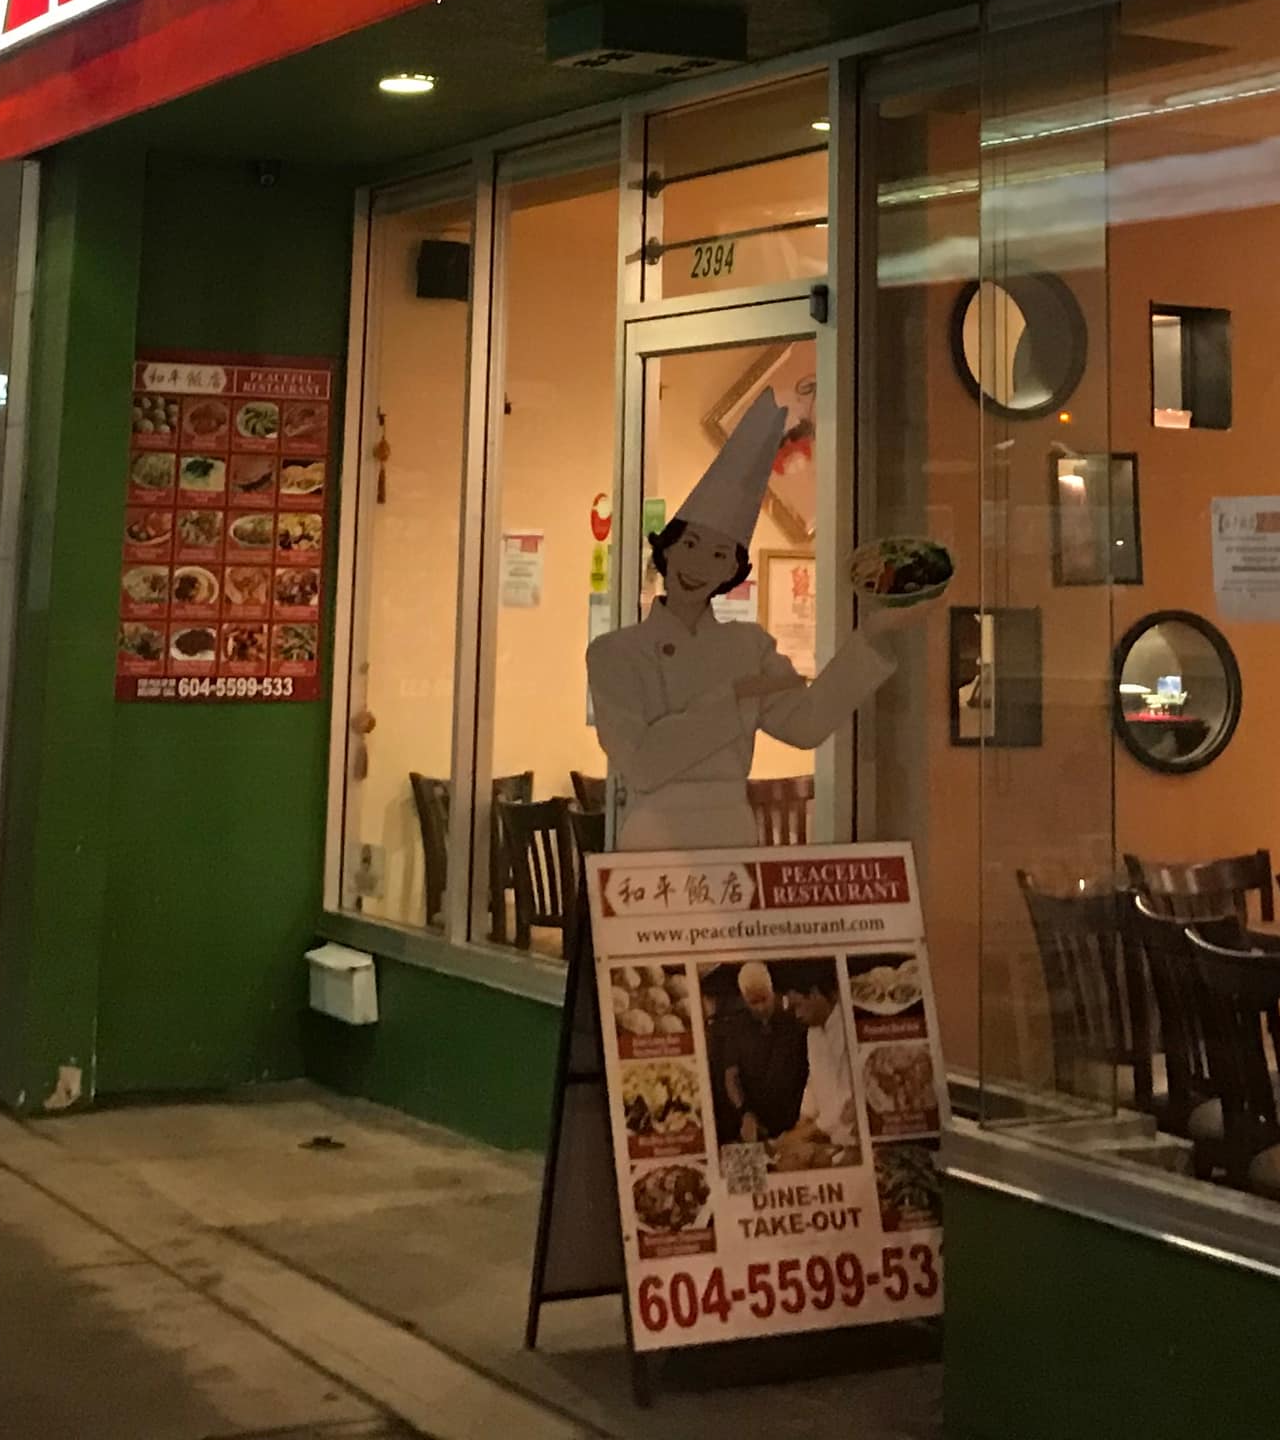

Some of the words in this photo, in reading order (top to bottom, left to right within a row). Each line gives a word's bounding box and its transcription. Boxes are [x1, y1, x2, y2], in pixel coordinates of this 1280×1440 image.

[690, 241, 736, 279] 2394
[243, 382, 320, 395] RESTAURANT
[250, 371, 313, 384] PEACEFUL
[178, 676, 294, 697] 604-5599-533
[782, 862, 890, 885] PEACEFUL
[618, 871, 744, 908] 和平飯店
[773, 880, 901, 905] RESTAURANT
[636, 917, 885, 945] www.peacefulrestaurant.com
[752, 1182, 844, 1211] DINE-IN
[738, 1207, 863, 1240] TAKE-OUT
[637, 1243, 944, 1332] 604-5599-53
